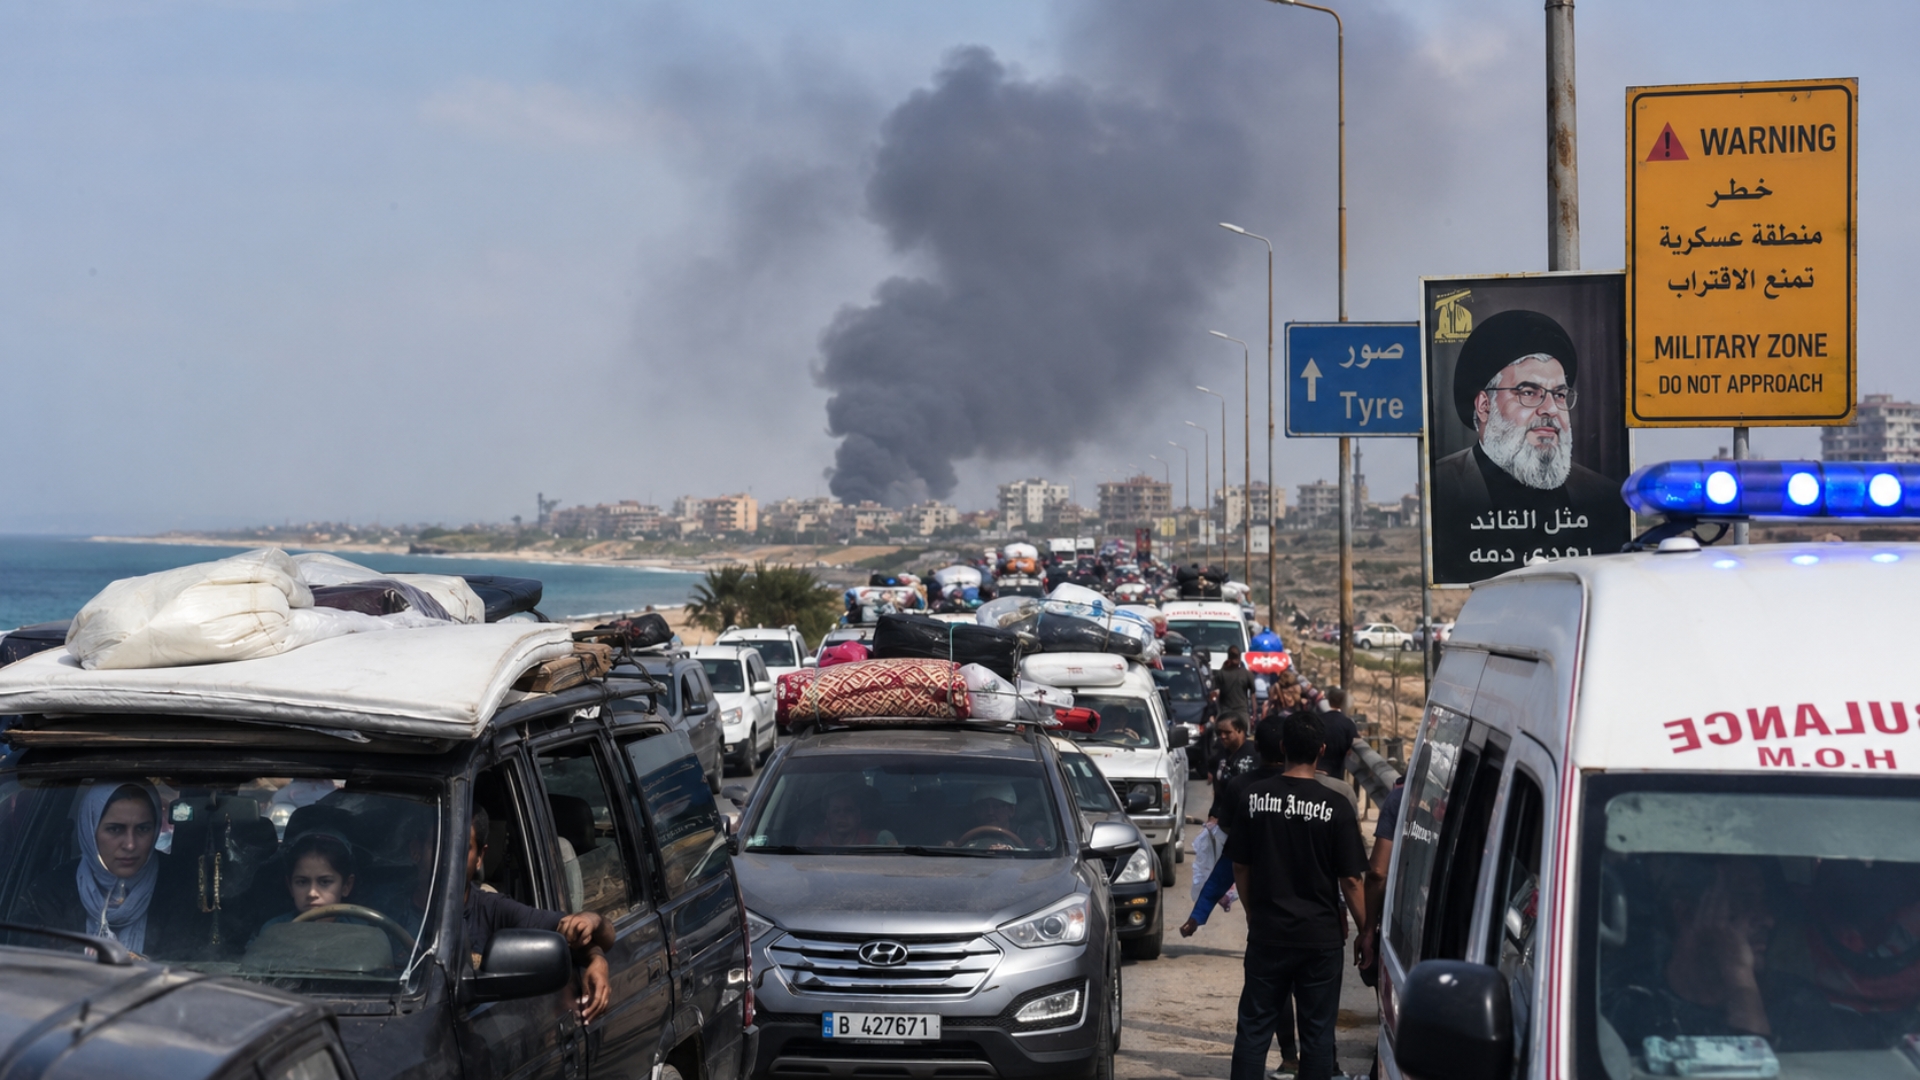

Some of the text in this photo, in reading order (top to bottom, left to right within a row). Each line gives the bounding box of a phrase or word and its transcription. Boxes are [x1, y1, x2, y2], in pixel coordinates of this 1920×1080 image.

[1700, 123, 1836, 156] WARNING
[1706, 178, 1773, 208] خطر
[1660, 223, 1822, 255] منطقة عسكرية
[1668, 266, 1814, 299] تمنع الاقتراب
[1338, 343, 1404, 369] صور
[1655, 333, 1828, 359] MILITARY ZONE
[1659, 373, 1823, 394] DO NOT APPROACH
[1339, 391, 1404, 426] Tyre
[1544, 507, 1589, 535] مثل
[1469, 547, 1515, 563] دمه
[1249, 792, 1333, 822] Palm Angels
[839, 1016, 927, 1036] B 427671
